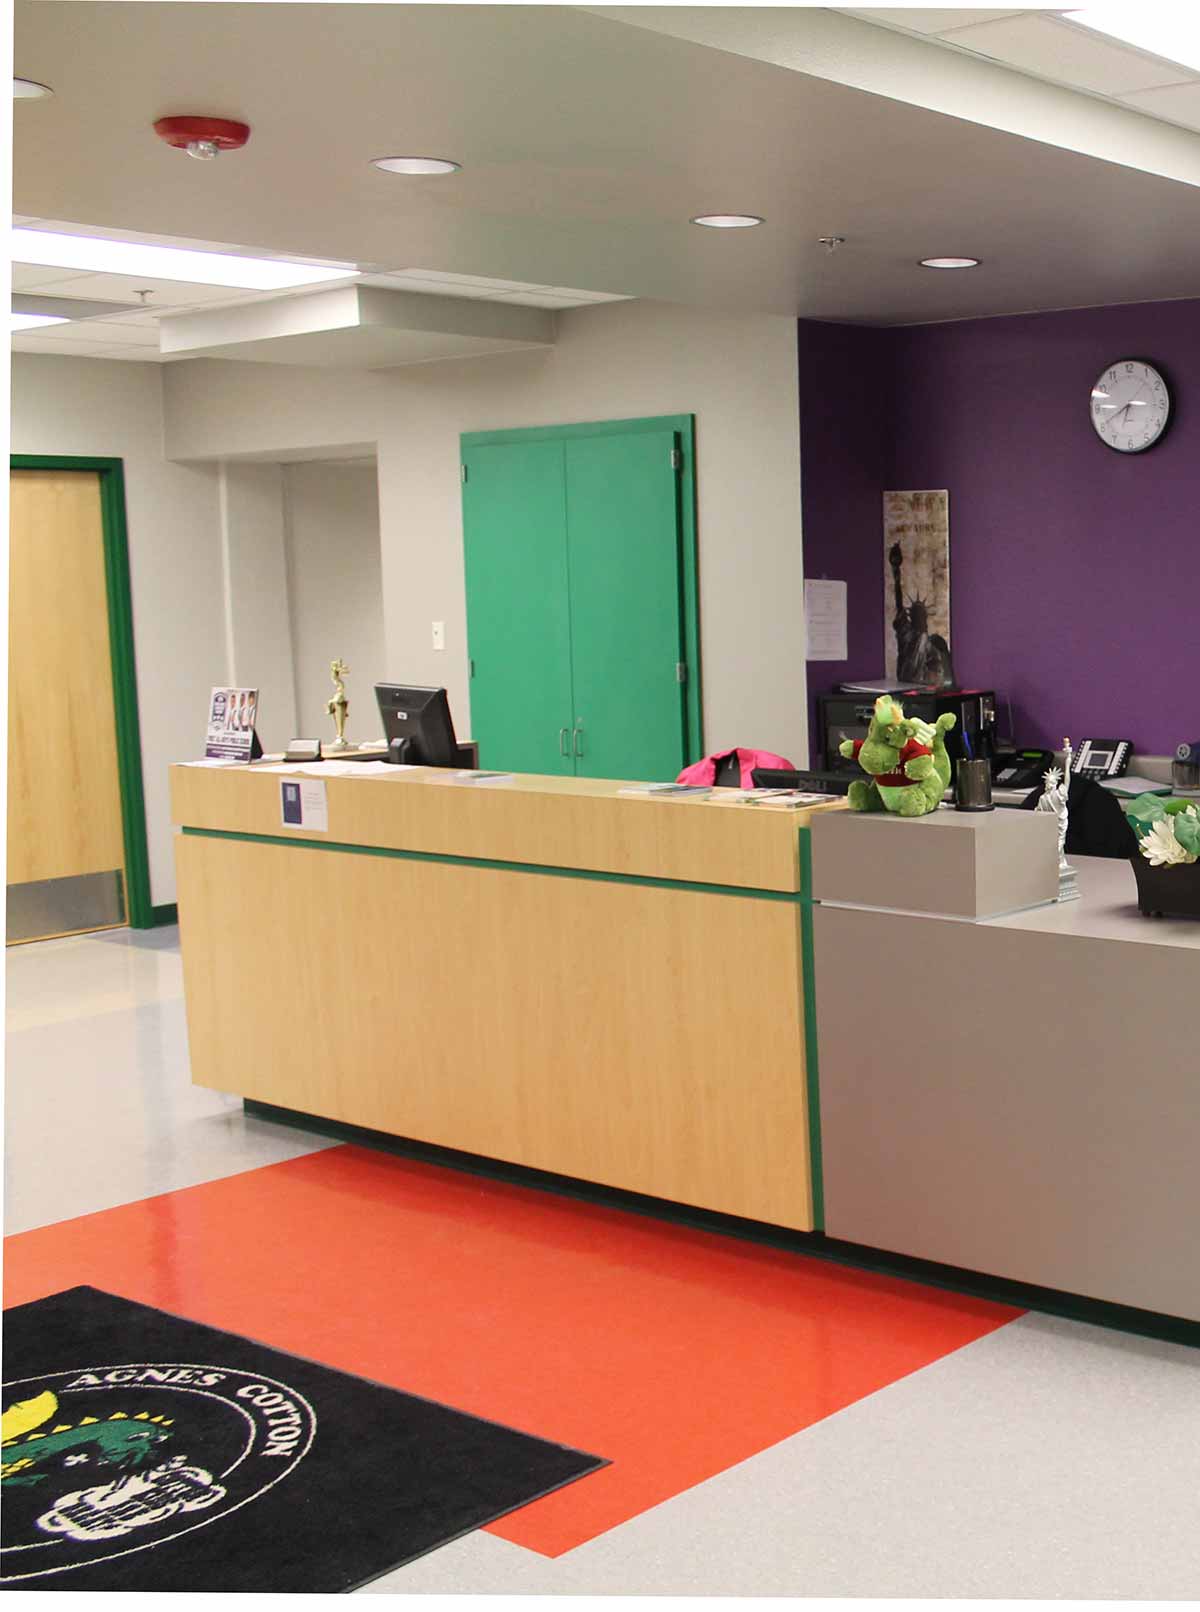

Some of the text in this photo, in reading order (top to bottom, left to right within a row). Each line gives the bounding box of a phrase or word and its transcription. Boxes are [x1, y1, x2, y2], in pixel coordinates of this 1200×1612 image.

[1125, 363, 1134, 373] 12
[1109, 371, 1117, 380] 11
[1154, 381, 1161, 391] 2
[1159, 399, 1165, 409] 3
[1112, 434, 1118, 444] 7
[1144, 433, 1151, 444] 5
[1128, 439, 1134, 449] 6
[67, 1368, 302, 1456] AGNES COTTON
